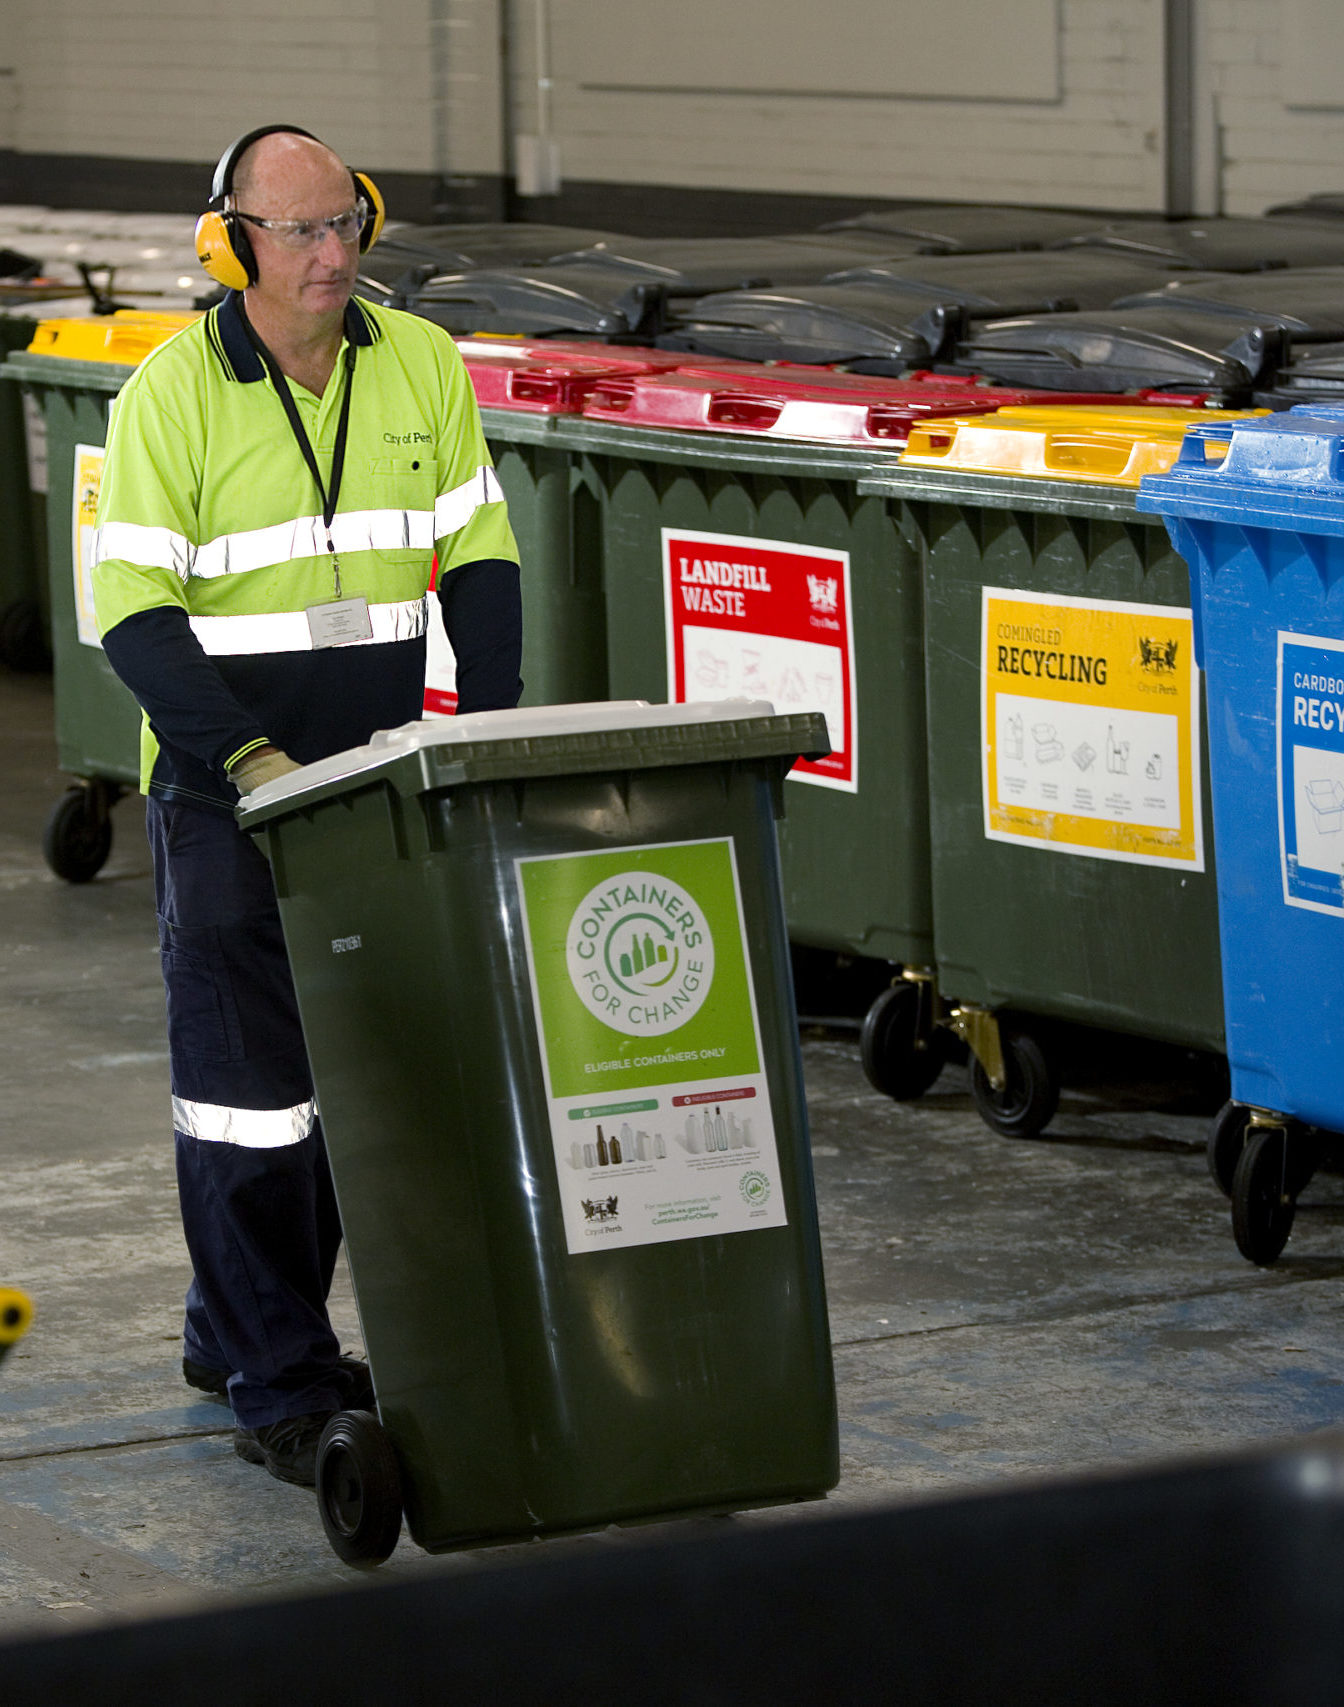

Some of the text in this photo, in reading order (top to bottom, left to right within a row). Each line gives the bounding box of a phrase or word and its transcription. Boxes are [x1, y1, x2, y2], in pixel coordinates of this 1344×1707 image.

[679, 558, 771, 592] LANDFILL
[681, 586, 746, 617] WASTE
[997, 623, 1061, 646] COMINGLED
[997, 645, 1107, 685] RECYCLING
[1294, 672, 1344, 695] CARDBO
[1294, 696, 1344, 733] RECY
[577, 884, 702, 959] CONTAINERS
[582, 960, 704, 1024] FOR CHANGE
[584, 1047, 726, 1073] ELIGIBLE CONTAINERS ONLY
